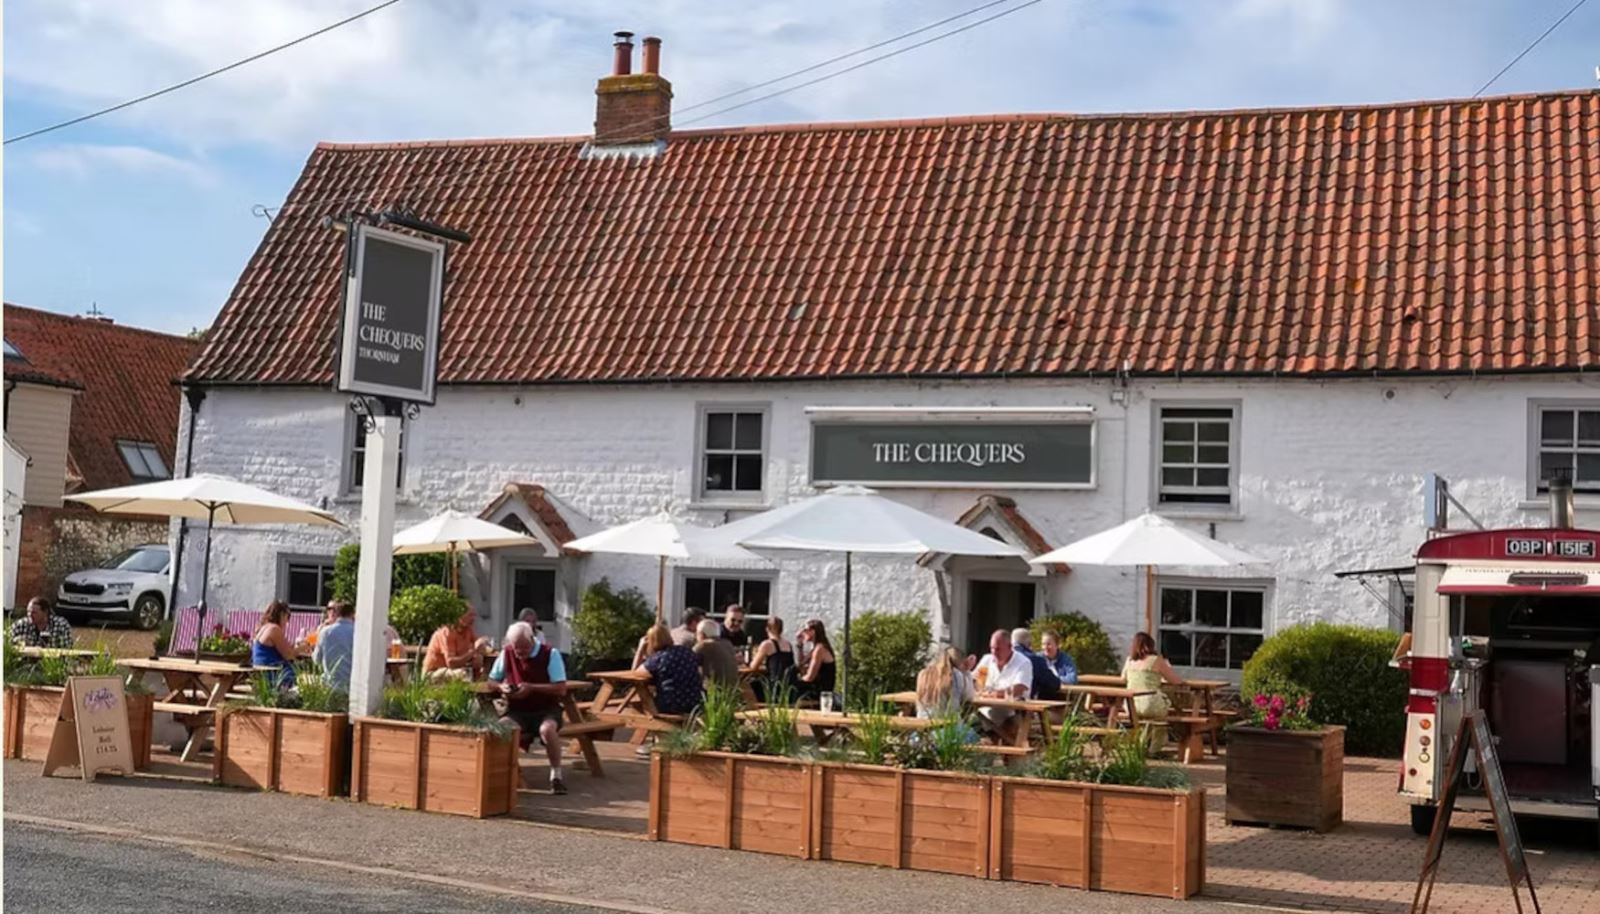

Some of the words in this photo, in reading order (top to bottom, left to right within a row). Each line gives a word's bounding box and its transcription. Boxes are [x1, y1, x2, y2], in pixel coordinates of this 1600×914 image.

[362, 301, 387, 322] THE
[360, 324, 425, 352] CHEQUERS
[872, 443, 911, 463] THE
[914, 443, 1026, 467] CHEQUERS
[1509, 541, 1542, 554] OBP
